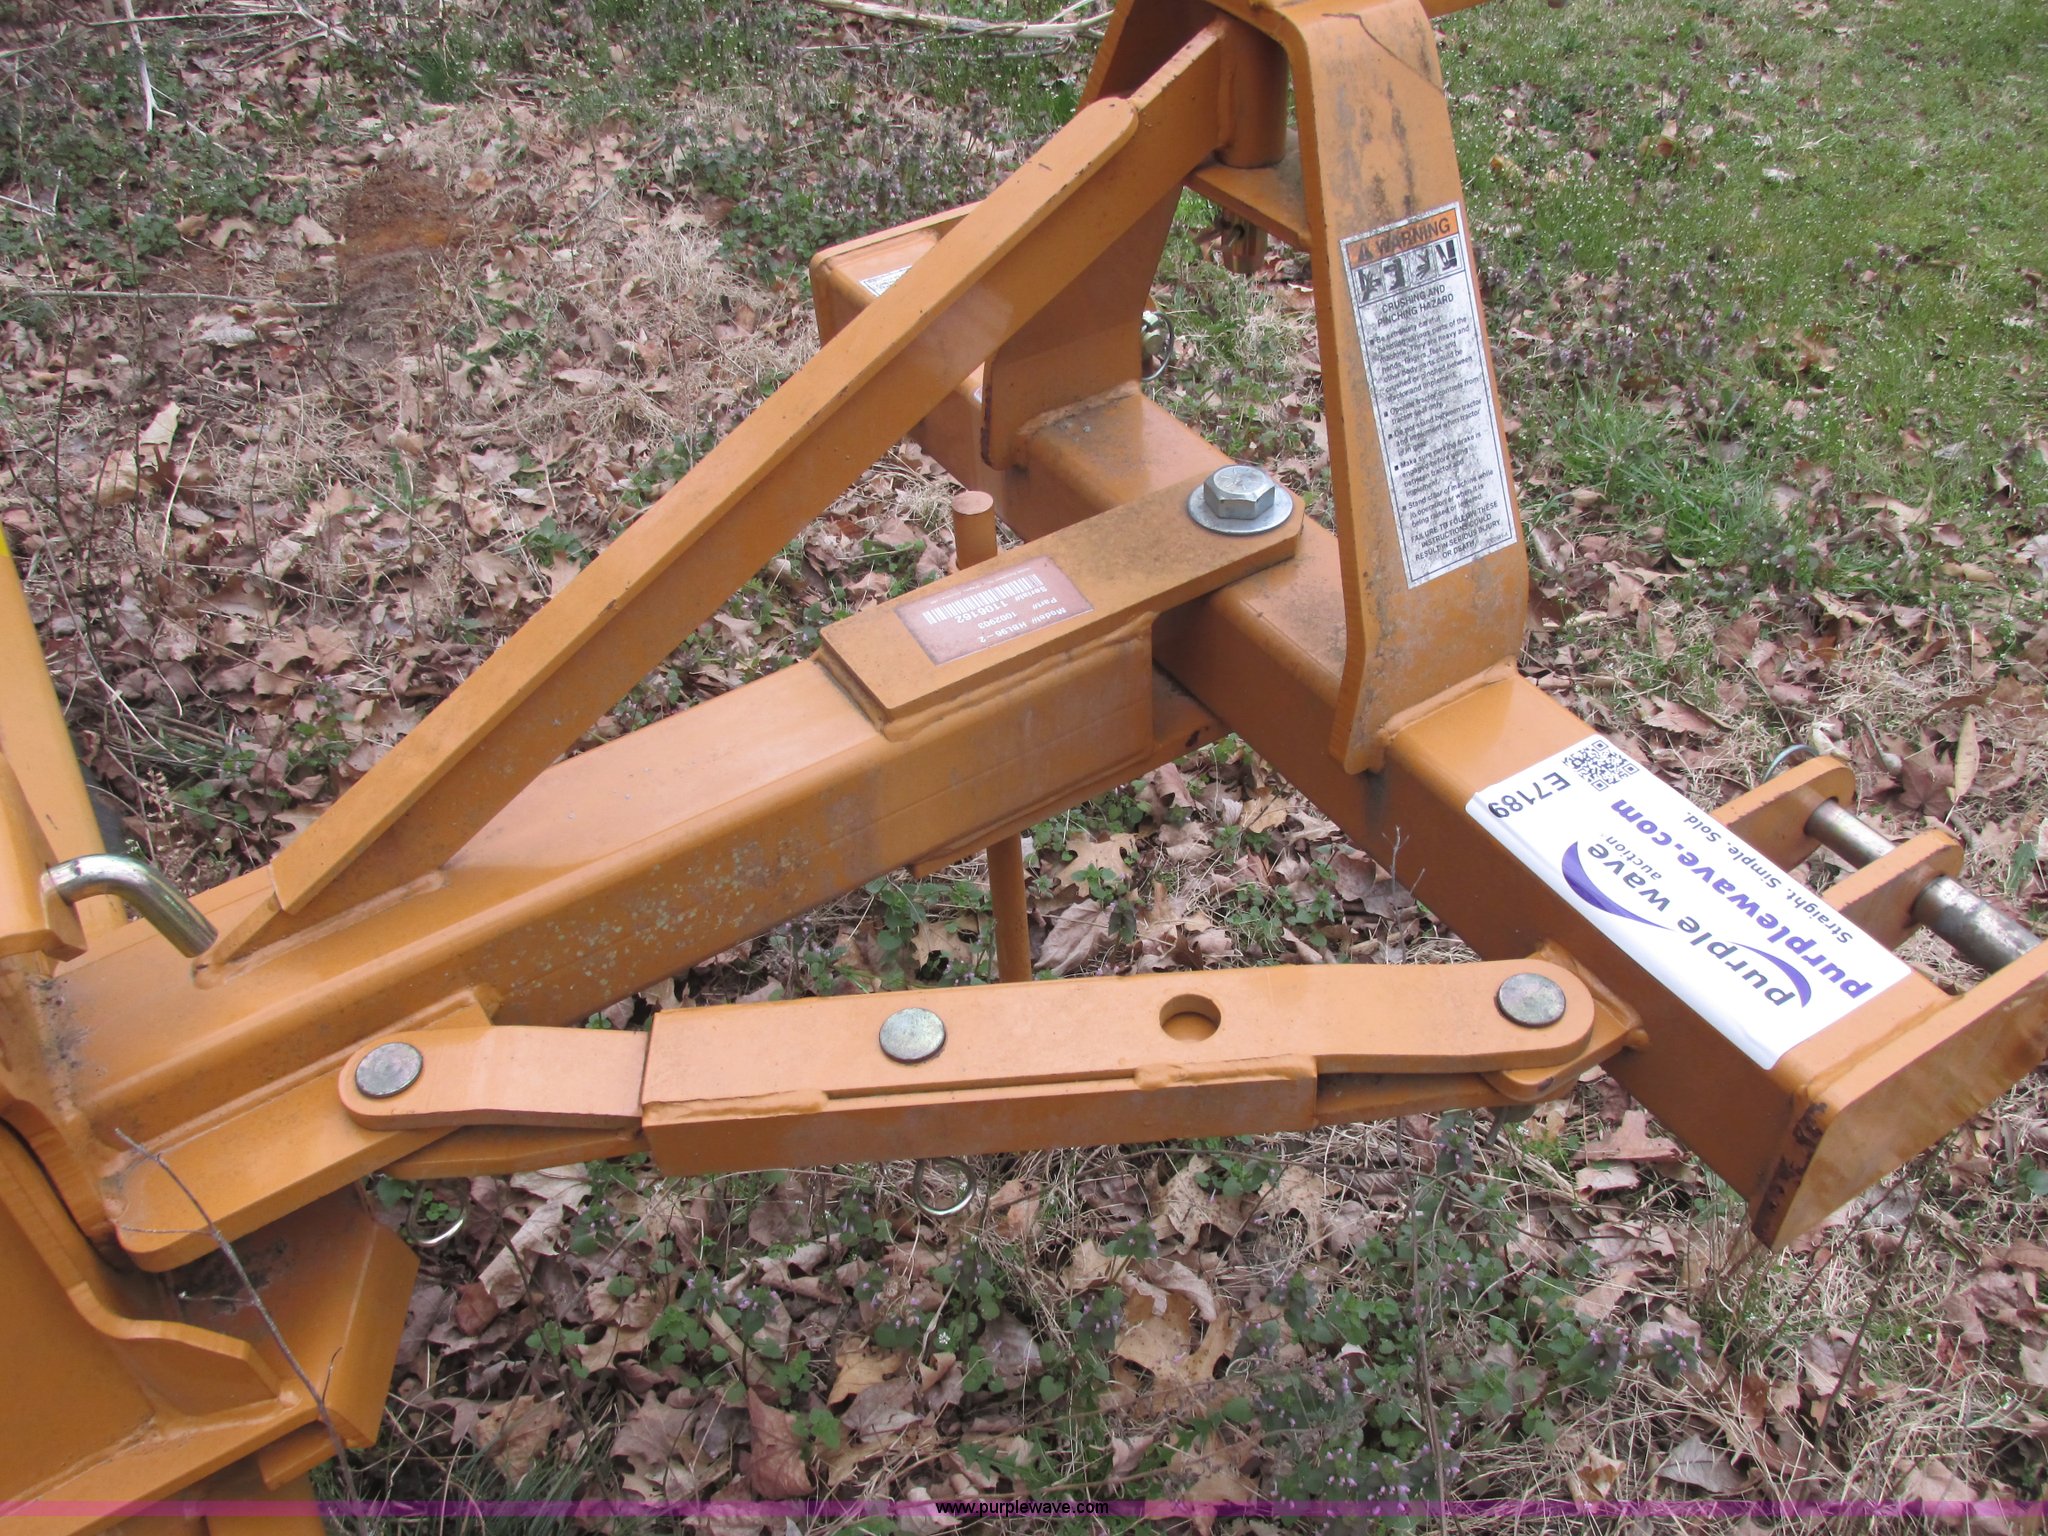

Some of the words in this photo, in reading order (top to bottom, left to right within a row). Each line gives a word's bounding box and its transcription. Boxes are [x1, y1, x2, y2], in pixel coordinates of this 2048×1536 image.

[1375, 216, 1451, 255] WARNING
[1376, 305, 1417, 327] PINCHING
[1419, 292, 1454, 312] HAZARD
[1381, 290, 1426, 314] CRUSHING
[1426, 283, 1445, 298] AND
[1375, 334, 1385, 343] Be
[1409, 341, 1426, 354] They
[1426, 336, 1437, 346] are
[1437, 329, 1457, 343] heavy
[1457, 324, 1469, 335] and
[1431, 322, 1448, 335] parts
[1448, 319, 1456, 328] of
[1456, 315, 1466, 325] the
[1443, 339, 1456, 349] and
[1382, 371, 1400, 383] other
[1400, 364, 1418, 378] body
[1418, 358, 1435, 371] parts
[1435, 351, 1454, 363] could
[1454, 348, 1463, 356] be
[1384, 377, 1411, 393] crushed
[1411, 374, 1419, 383] or
[1420, 364, 1446, 381] pinched
[1446, 354, 1472, 370] between
[1386, 388, 1409, 403] tractor
[1409, 384, 1421, 394] and
[1389, 399, 1415, 416] Operate
[1415, 391, 1437, 405] tractor
[1437, 381, 1463, 396] controls
[1463, 375, 1479, 386] from
[1391, 411, 1413, 425] tractor
[1393, 428, 1403, 437] Do
[1403, 424, 1415, 433] not
[1415, 416, 1434, 428] stand
[1434, 406, 1461, 421] between
[1461, 398, 1481, 411] tractor
[1395, 436, 1408, 447] and
[1408, 423, 1442, 443] implement
[1442, 416, 1459, 428] when
[1459, 408, 1480, 422] tractor
[1399, 456, 1417, 468] Make
[1417, 450, 1432, 461] sure
[1432, 441, 1456, 457] parking
[1456, 433, 1474, 446] brake
[1474, 431, 1481, 439] is
[1401, 461, 1429, 479] engaged
[1429, 453, 1450, 467] before
[1450, 446, 1468, 460] going
[1404, 445, 1411, 453] in
[1403, 471, 1429, 488] between
[1429, 462, 1452, 477] tractor
[1452, 457, 1464, 468] and
[1407, 495, 1426, 509] Stand
[1443, 485, 1450, 494] of
[1450, 475, 1477, 491] machine
[1477, 468, 1493, 480] while
[1411, 514, 1429, 529] being
[1429, 506, 1449, 520] raised
[1449, 503, 1457, 512] or
[1416, 497, 1447, 516] operation
[1447, 494, 1454, 502] or
[1454, 487, 1471, 499] when
[1477, 482, 1484, 490] is
[1410, 525, 1437, 543] FAILURE
[1438, 520, 1448, 531] TO
[1448, 508, 1477, 527] FOLLOW
[1477, 499, 1498, 515] THESE
[1420, 522, 1468, 548] INSTRUCTIONS
[1468, 512, 1491, 528] COULD
[1414, 543, 1440, 561] RESULT
[1440, 540, 1448, 550] IN
[1448, 528, 1477, 547] SERIOUS
[1477, 518, 1501, 534] INJURY
[1441, 549, 1452, 559] OR
[1012, 585, 1049, 602] Serial#
[1029, 596, 1058, 610] Part#
[975, 610, 1018, 630] 1002903
[1029, 606, 1067, 624] Model#
[1488, 771, 1573, 820] E7189
[1683, 811, 1724, 843] Sold.
[1603, 836, 1663, 881] auction
[1726, 840, 1783, 889] Simple.
[1587, 840, 1671, 913] wave
[1610, 798, 1873, 1000] purplewave.com
[1785, 888, 1854, 945] Straight.
[1678, 915, 1796, 1007] purple
